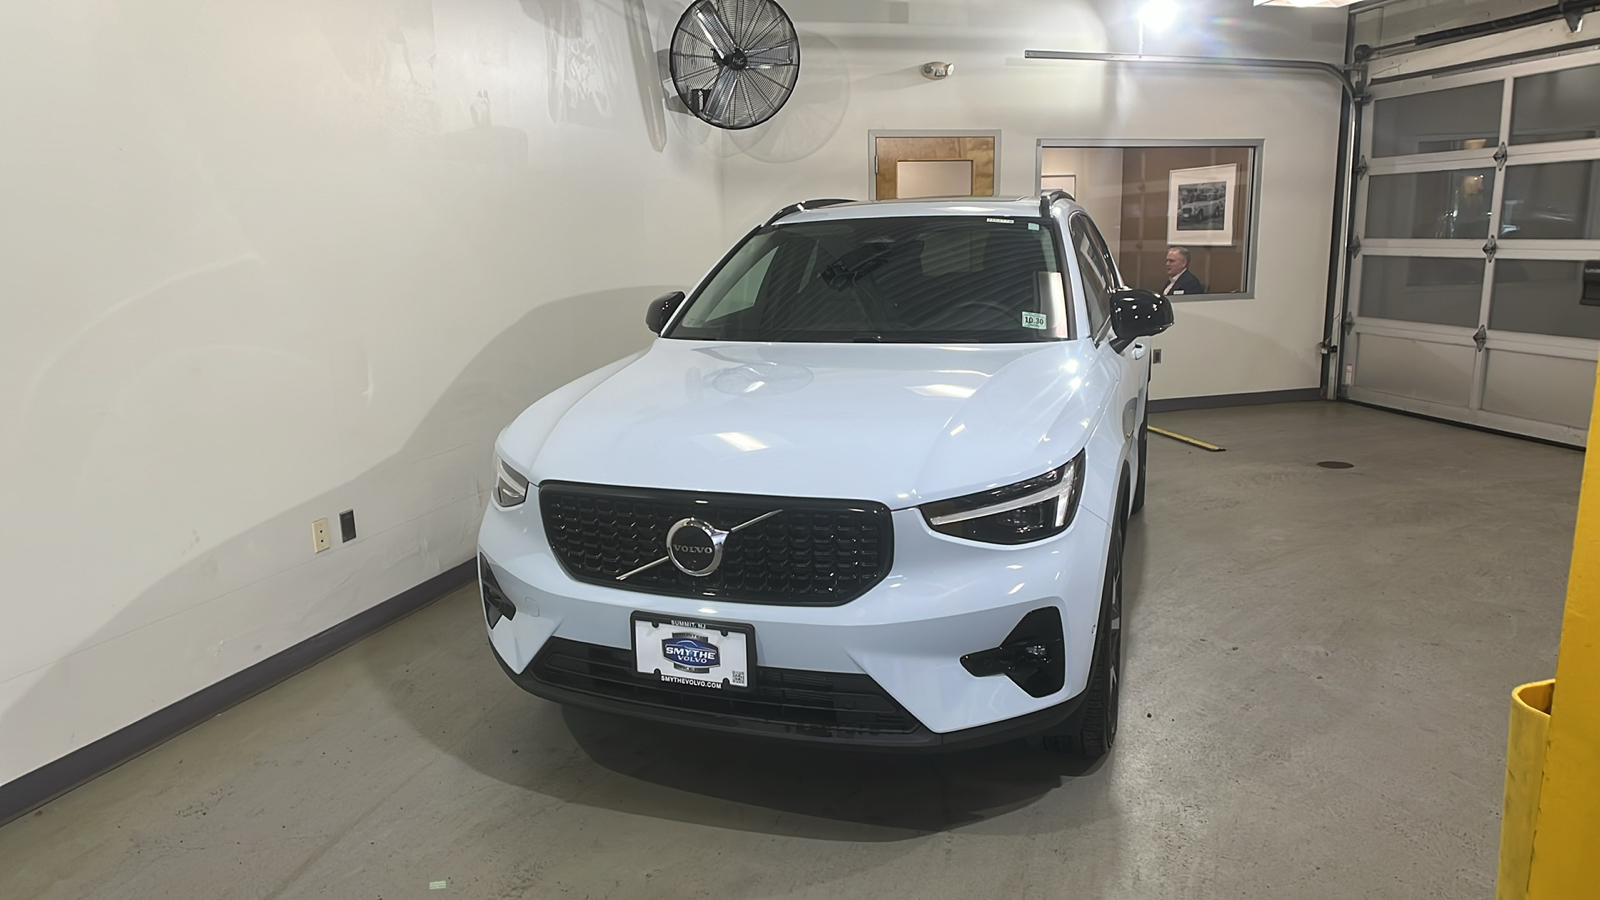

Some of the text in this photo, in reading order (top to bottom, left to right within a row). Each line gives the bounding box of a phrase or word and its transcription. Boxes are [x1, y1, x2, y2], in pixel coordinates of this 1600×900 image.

[673, 544, 713, 554] VOLVO
[665, 646, 716, 660] SMYTHE
[677, 654, 708, 664] VOLVO
[661, 675, 722, 689] SMYTHEVOLVO.COM
